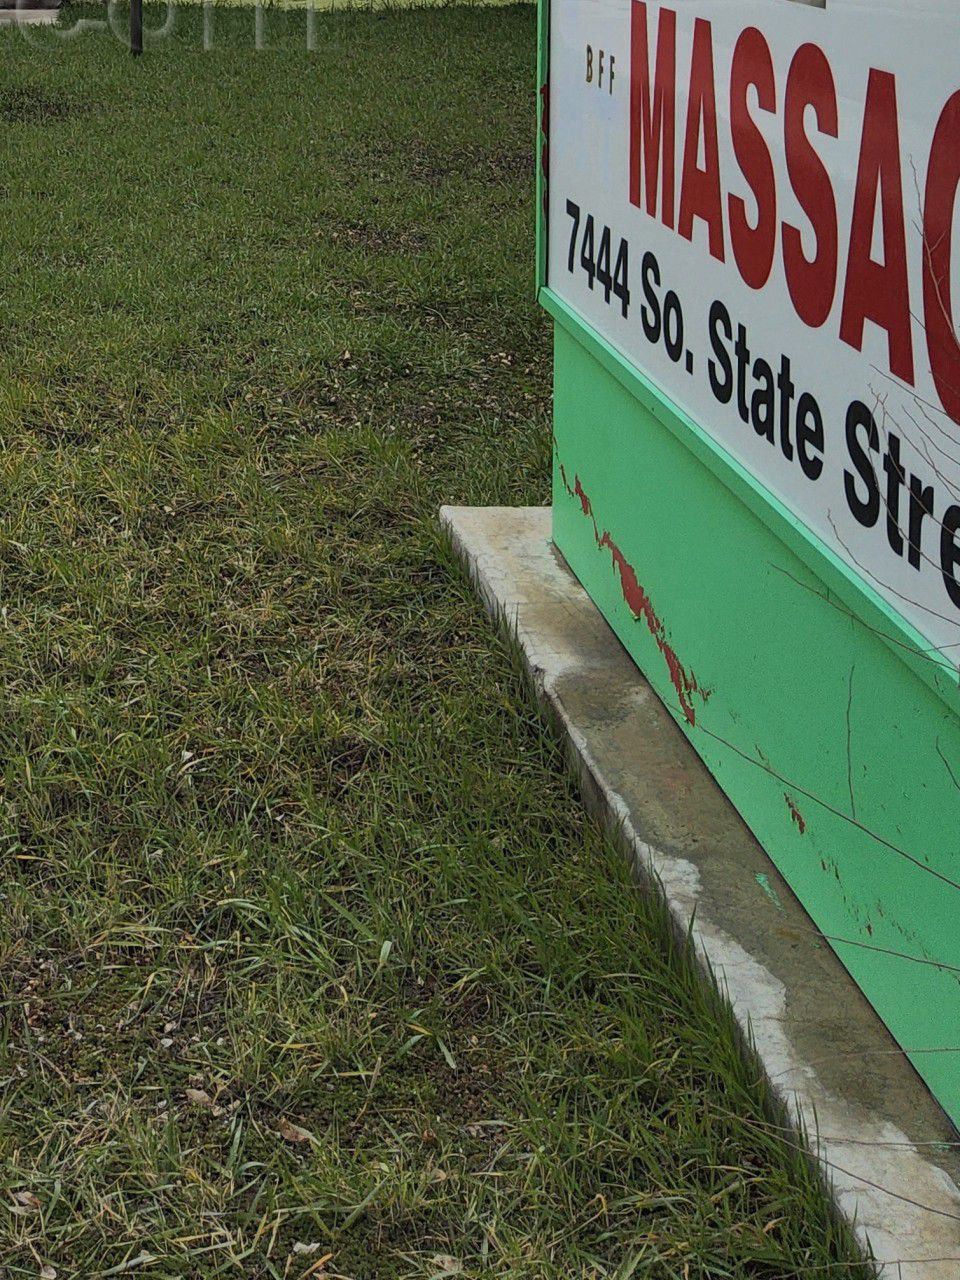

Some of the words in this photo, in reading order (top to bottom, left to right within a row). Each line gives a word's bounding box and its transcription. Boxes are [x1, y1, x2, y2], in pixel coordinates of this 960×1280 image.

[566, 198, 630, 320] 7444
[641, 251, 694, 376] So.
[708, 300, 825, 481] State
